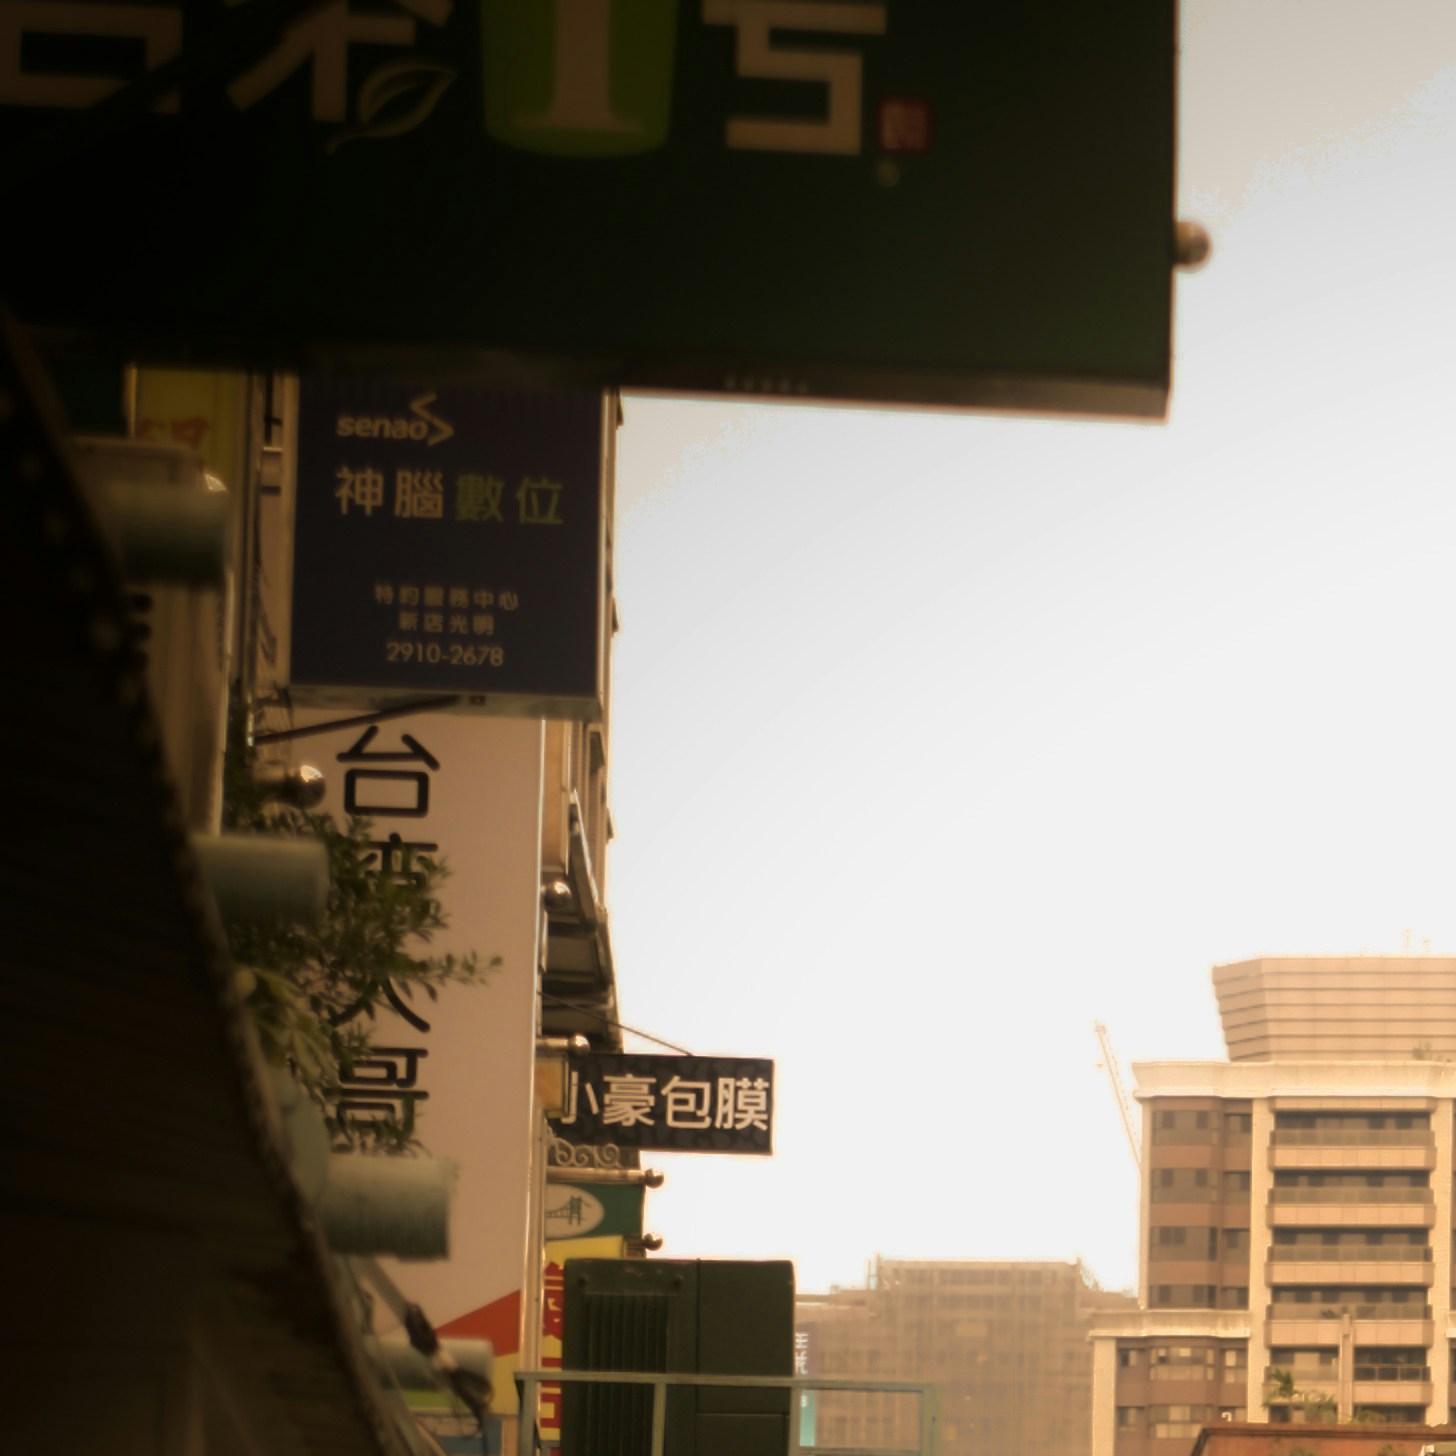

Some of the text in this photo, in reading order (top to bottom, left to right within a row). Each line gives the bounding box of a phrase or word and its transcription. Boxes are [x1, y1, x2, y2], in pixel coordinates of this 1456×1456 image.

[336, 416, 429, 440] senao
[335, 466, 565, 525] 神腦數位
[386, 642, 505, 667] 2910-2678
[560, 1072, 769, 1131] 小豪包膜
